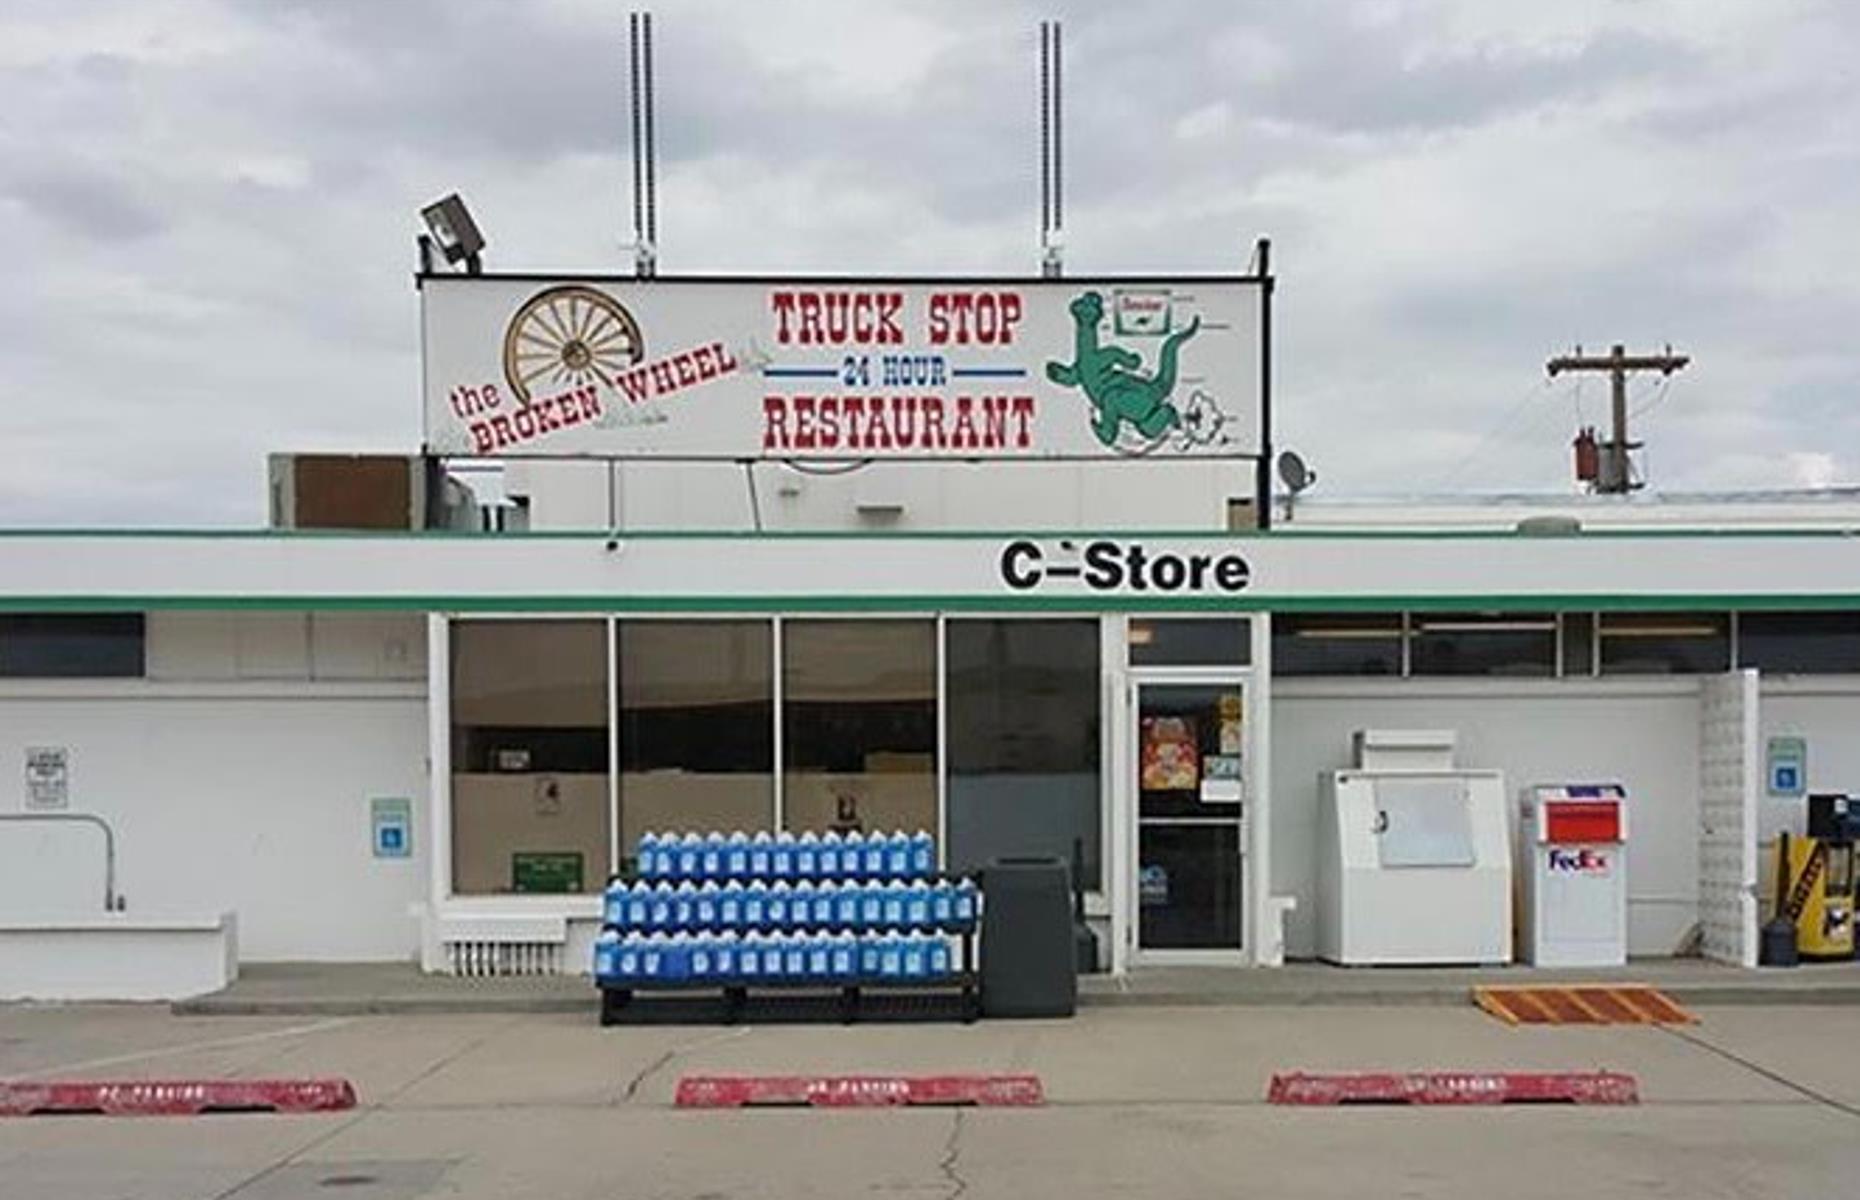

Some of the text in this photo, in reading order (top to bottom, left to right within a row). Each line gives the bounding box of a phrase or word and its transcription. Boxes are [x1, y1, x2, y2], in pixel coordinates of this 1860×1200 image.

[772, 292, 1022, 345] TRUCK STOP
[843, 356, 947, 386] 24 HOUR
[449, 384, 500, 419] the
[470, 342, 737, 455] BROKEN WHEEL
[763, 397, 1034, 448] RESTAURANT
[1001, 541, 1250, 591] C-Store
[1549, 850, 1606, 871] FedEx
